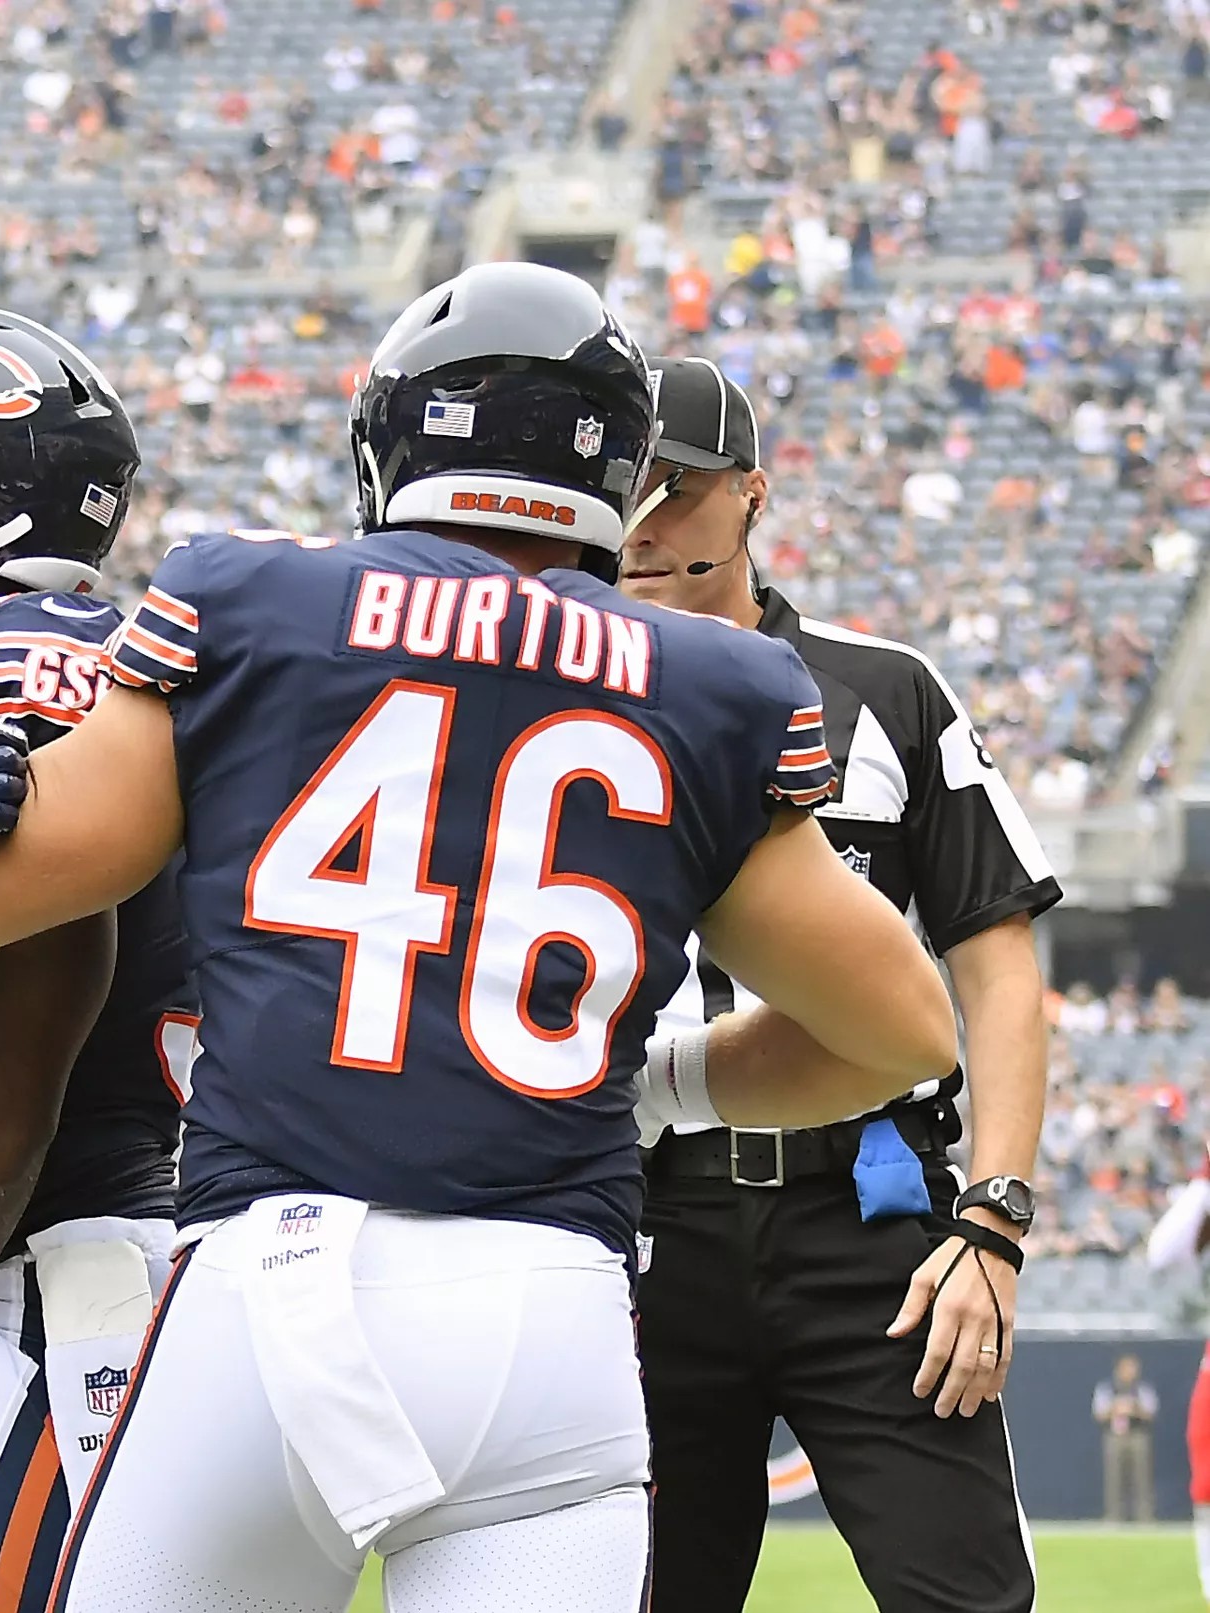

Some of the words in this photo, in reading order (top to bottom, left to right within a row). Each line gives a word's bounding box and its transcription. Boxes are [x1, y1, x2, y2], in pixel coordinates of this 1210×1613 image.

[450, 492, 576, 527] BEARS
[349, 570, 651, 699] BURTON
[243, 678, 673, 1100] 46
[281, 1218, 314, 1235] NFL
